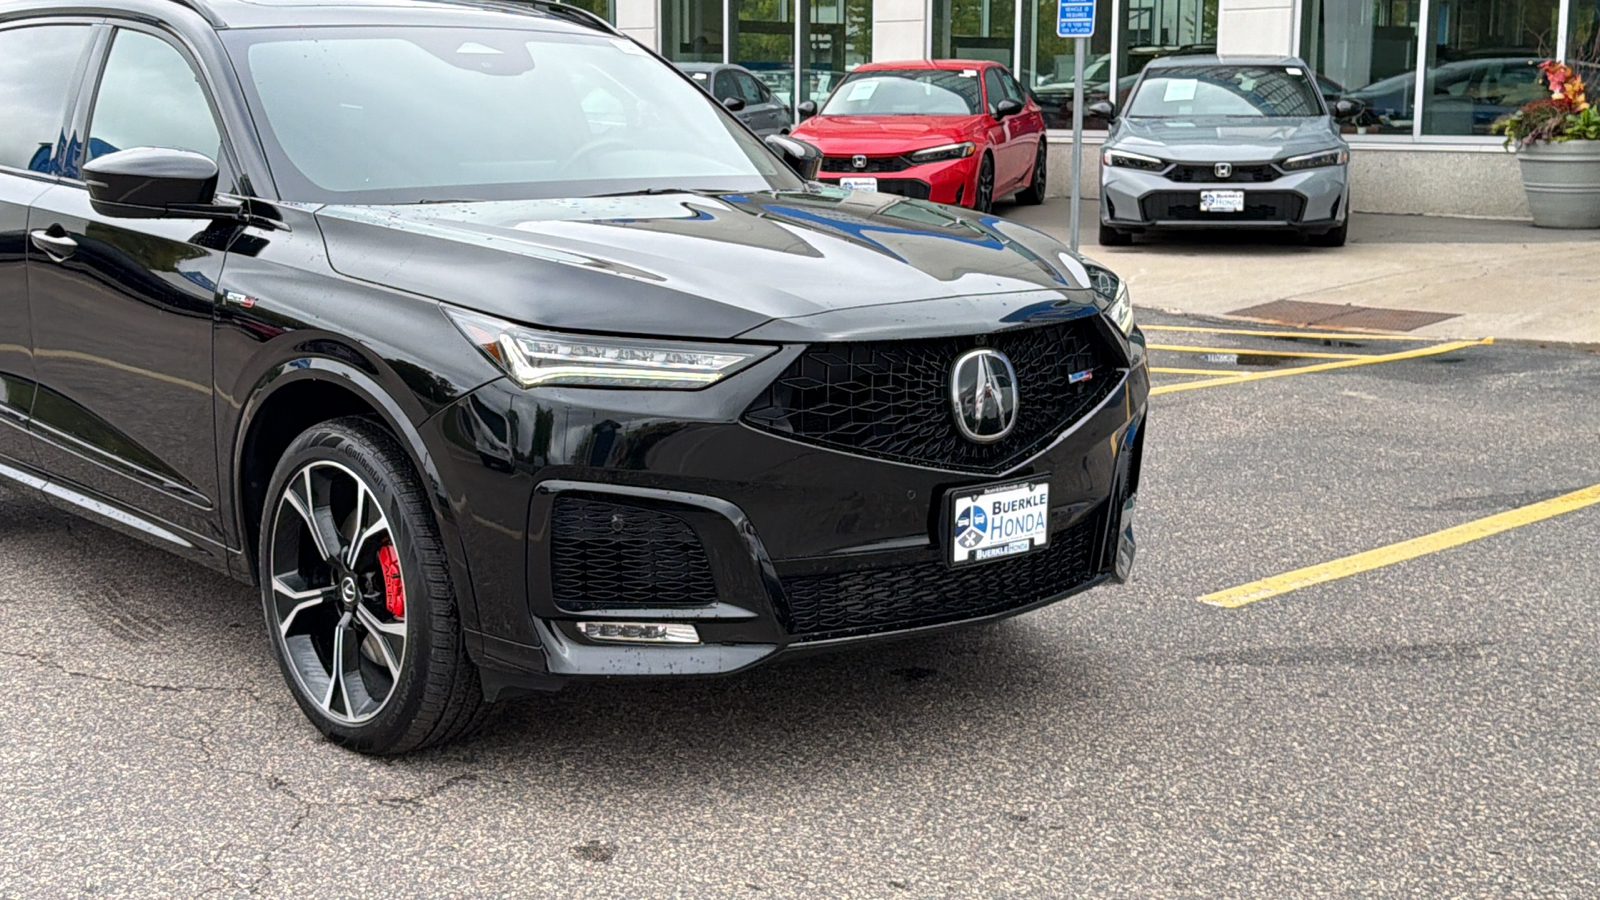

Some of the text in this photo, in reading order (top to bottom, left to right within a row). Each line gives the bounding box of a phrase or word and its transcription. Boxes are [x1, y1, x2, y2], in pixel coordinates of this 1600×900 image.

[992, 493, 1047, 516] BUERKLE
[990, 511, 1045, 541] HONDA
[976, 543, 1028, 559] BUERKLE HONDA
